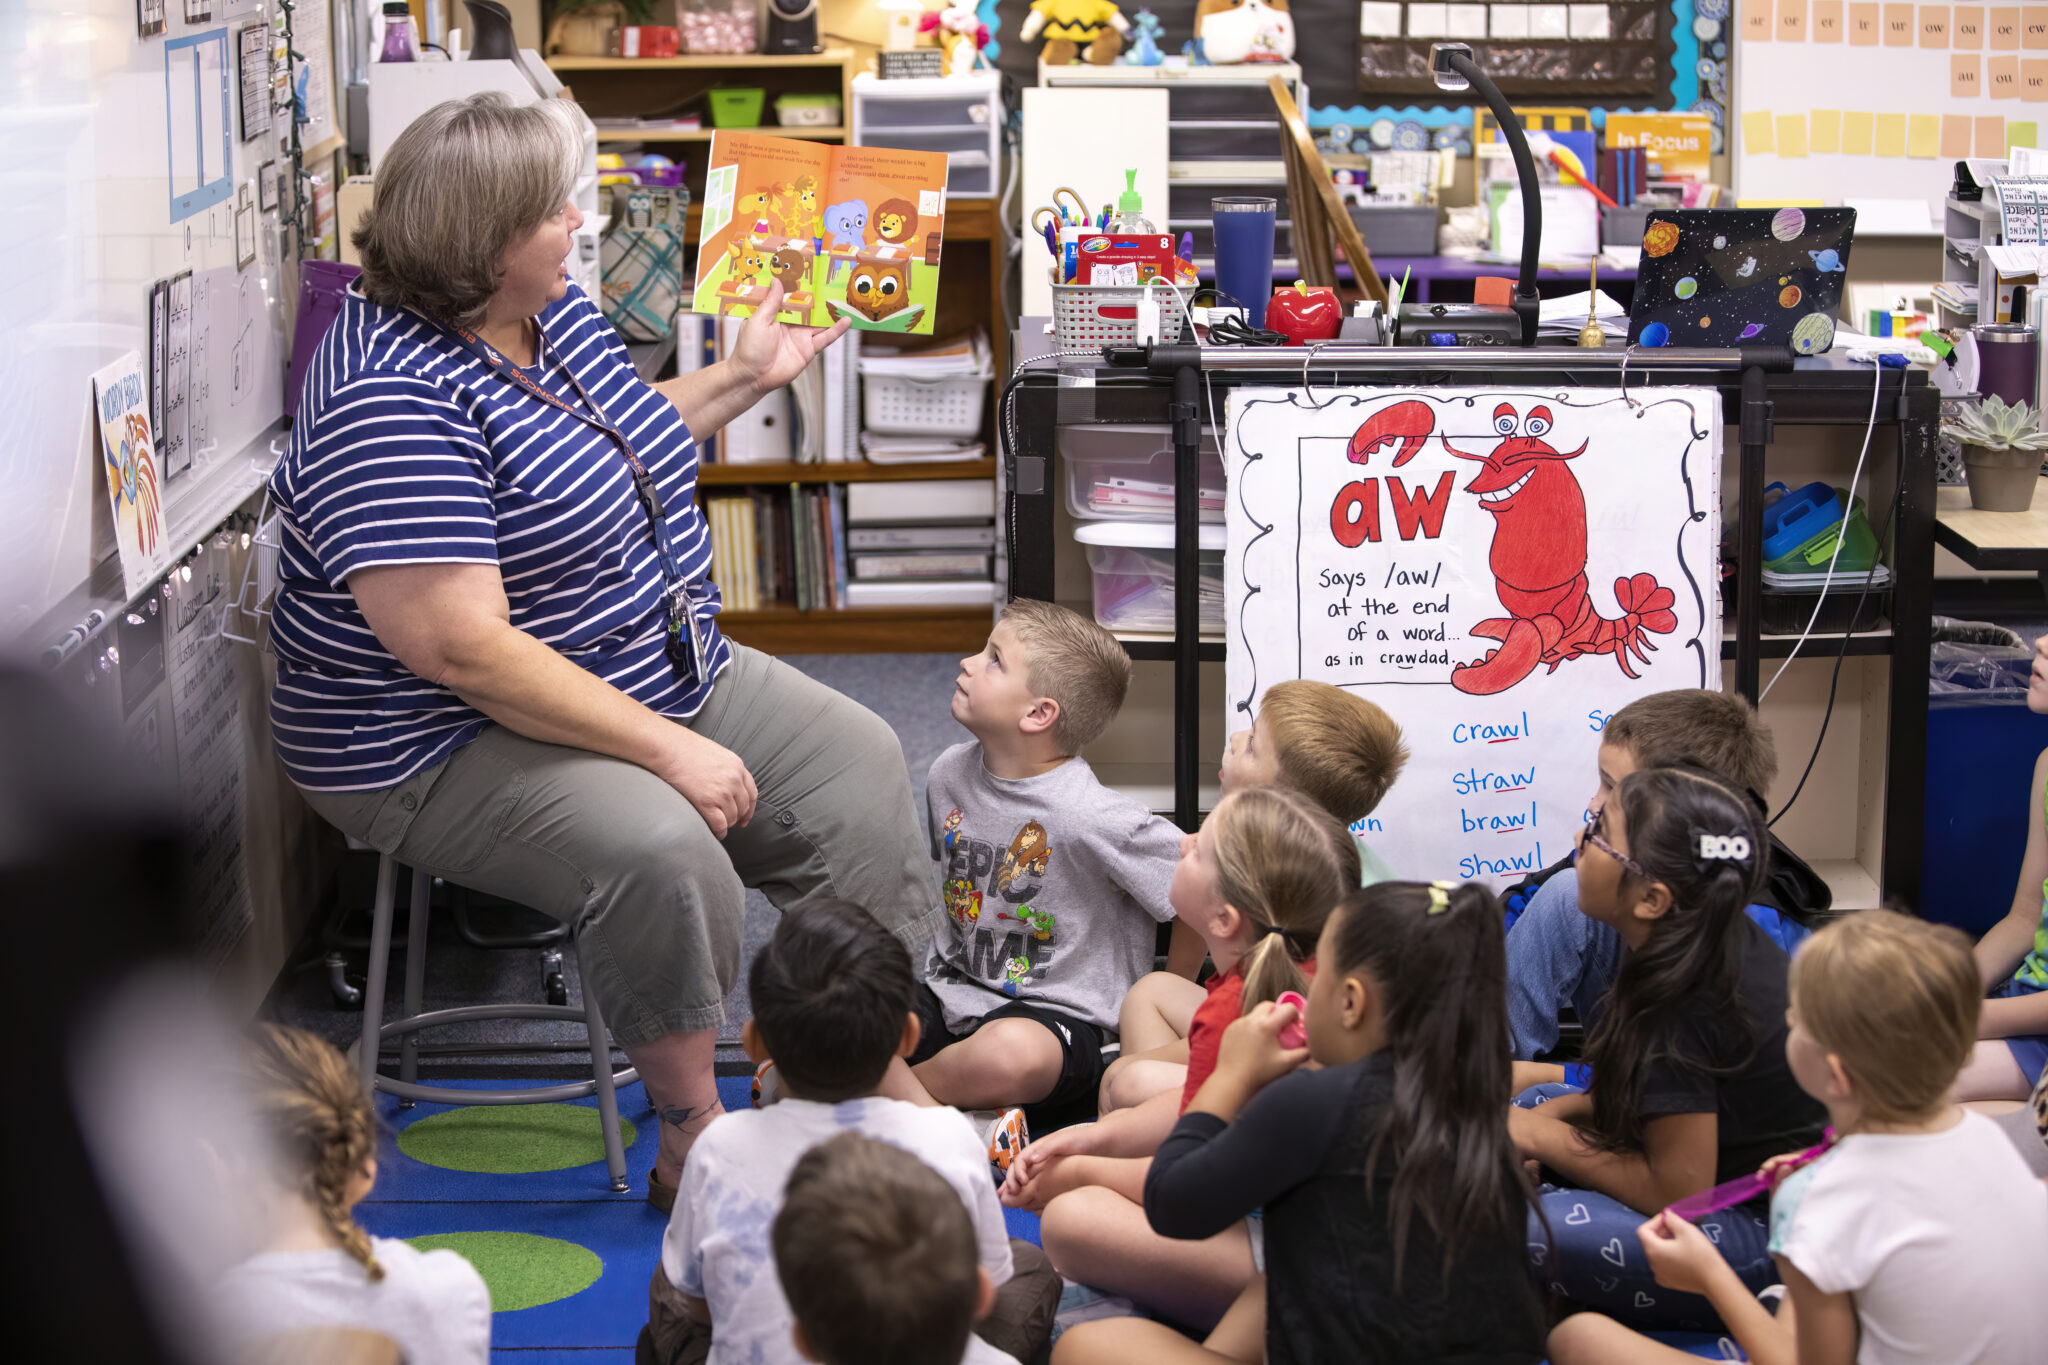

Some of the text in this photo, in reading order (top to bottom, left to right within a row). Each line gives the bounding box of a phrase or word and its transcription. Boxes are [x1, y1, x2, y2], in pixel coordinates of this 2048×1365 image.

[1750, 16, 1764, 26] ar
[1784, 16, 1800, 26] or
[1821, 18, 1835, 28] er
[1859, 20, 1870, 30] ir
[1891, 21, 1906, 32] ur
[1925, 24, 1944, 34] ow
[1961, 24, 1977, 34] oa
[1997, 25, 2012, 35] oe
[2028, 24, 2046, 34] ew
[1958, 72, 1974, 82] au
[1996, 74, 2012, 84] ou
[2028, 76, 2044, 87] ue
[1617, 131, 1700, 151] In Focus
[2009, 226, 2037, 235] MAKING
[1160, 238, 1169, 249] 8
[510, 368, 574, 412] BRONCOS
[102, 370, 143, 425] WORDY BIRDY
[1330, 470, 1456, 548] aw
[1384, 562, 1442, 589] /aw/
[1327, 594, 1450, 618] at the end
[1347, 621, 1369, 643] of
[1376, 629, 1389, 642] a
[1324, 654, 1342, 668] as
[1350, 651, 1364, 668] in
[1452, 711, 1529, 744] crawl
[1452, 766, 1535, 795] straw
[1349, 801, 1537, 834] wn brawl
[1700, 834, 1750, 861] BOO
[1459, 841, 1543, 879] shawl
[948, 834, 1042, 904] EPIC
